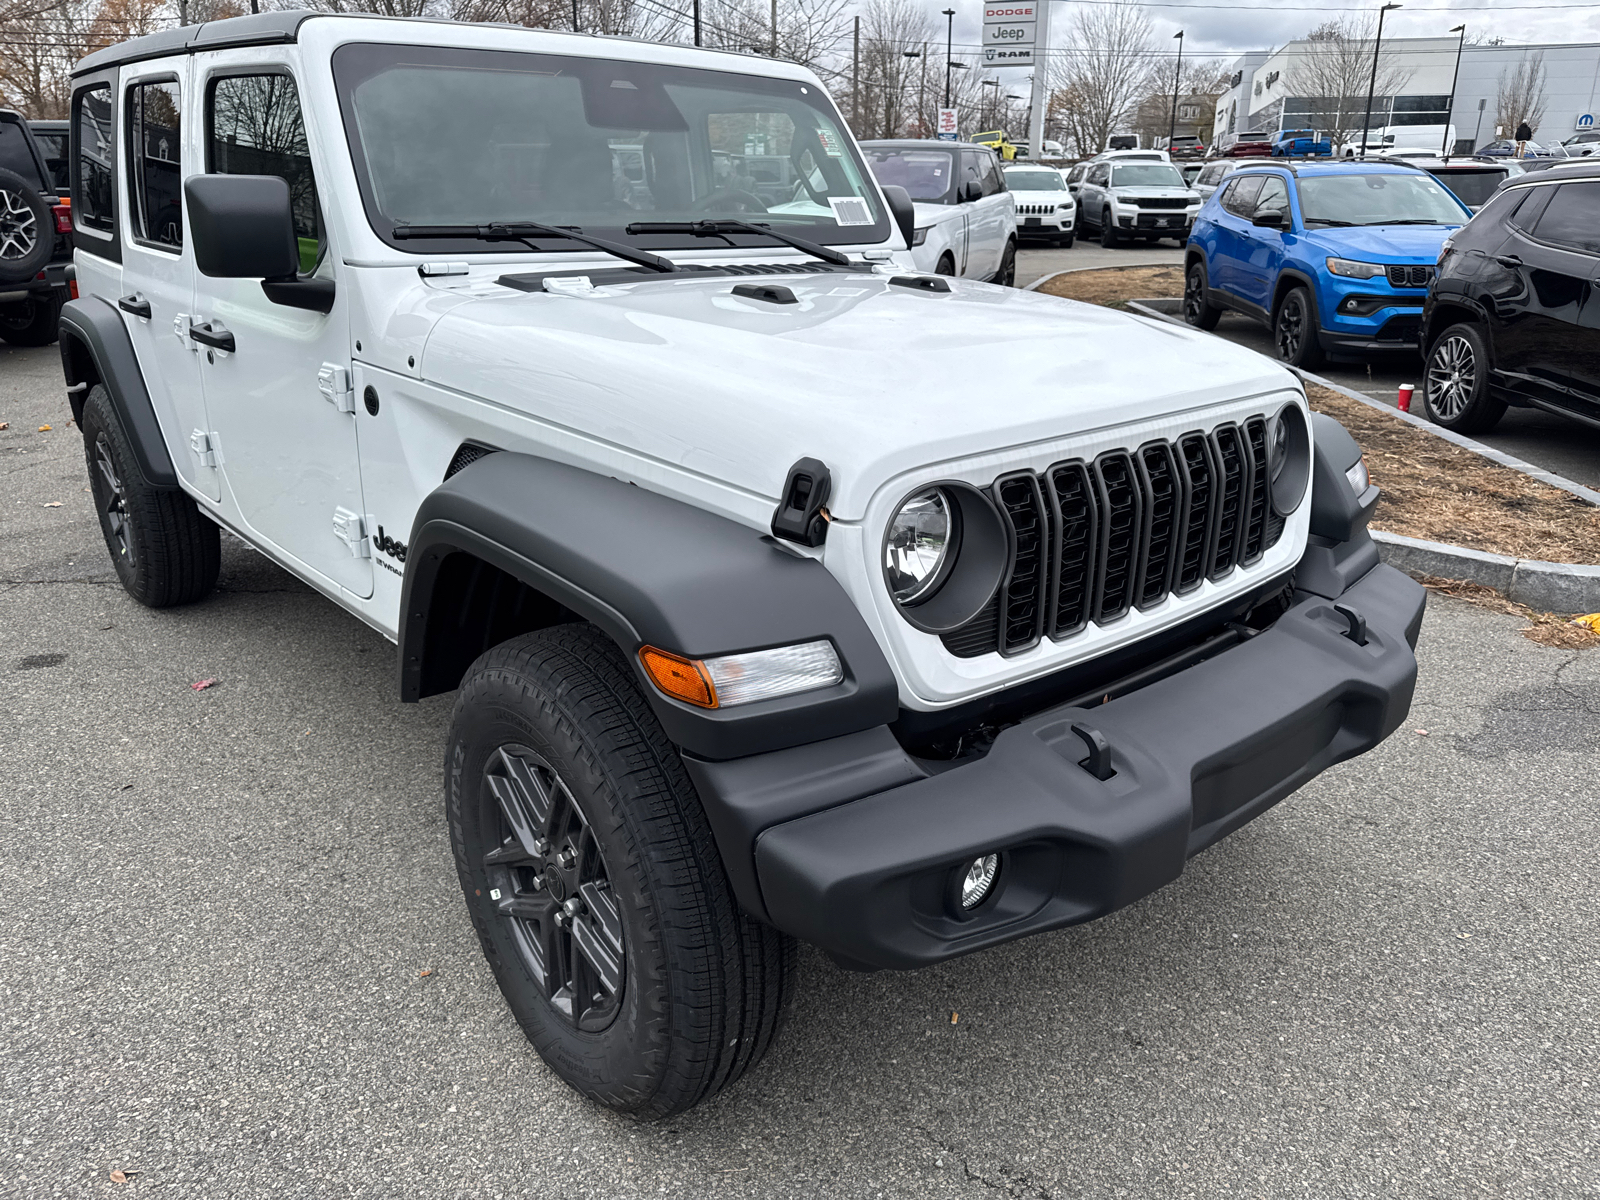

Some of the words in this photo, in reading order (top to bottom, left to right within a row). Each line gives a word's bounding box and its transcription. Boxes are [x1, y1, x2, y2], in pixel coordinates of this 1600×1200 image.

[986, 8, 1033, 17] DODGE
[992, 26, 1025, 41] Jeep
[452, 744, 465, 817] HTX2
